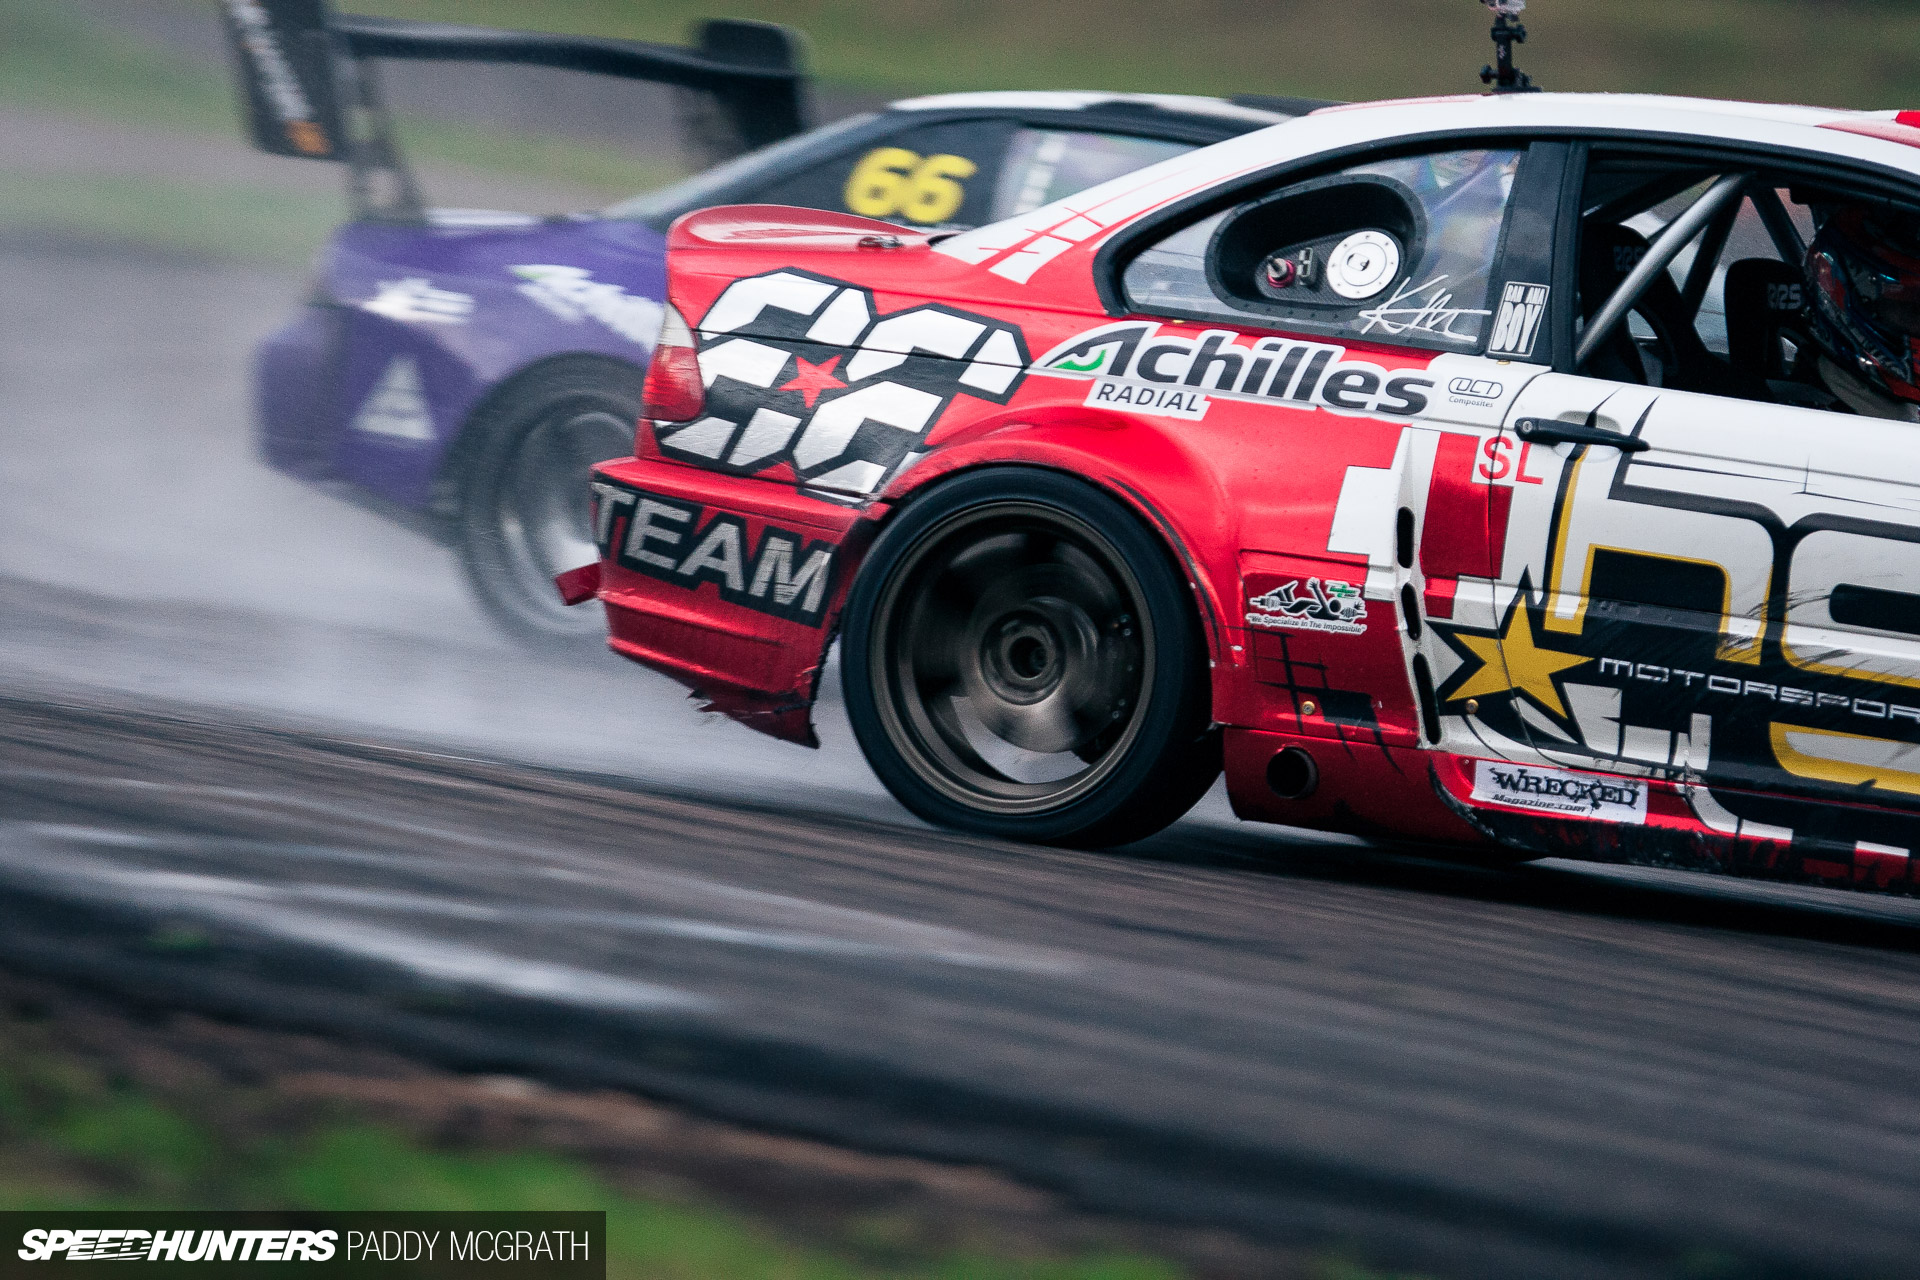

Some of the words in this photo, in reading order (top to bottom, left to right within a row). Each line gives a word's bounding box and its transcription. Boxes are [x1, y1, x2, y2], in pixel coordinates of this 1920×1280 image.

[845, 147, 978, 224] 66
[1491, 301, 1542, 353] BOY
[1045, 325, 1436, 416] Achilles
[1097, 383, 1201, 412] RADIAL
[1448, 395, 1495, 408] Composites
[1478, 435, 1545, 485] SL
[591, 481, 832, 614] TEAM
[1264, 616, 1299, 627] Specialize
[1310, 620, 1322, 629] The
[1489, 767, 1641, 810] WRECKED
[1493, 793, 1587, 813] Magazine.com
